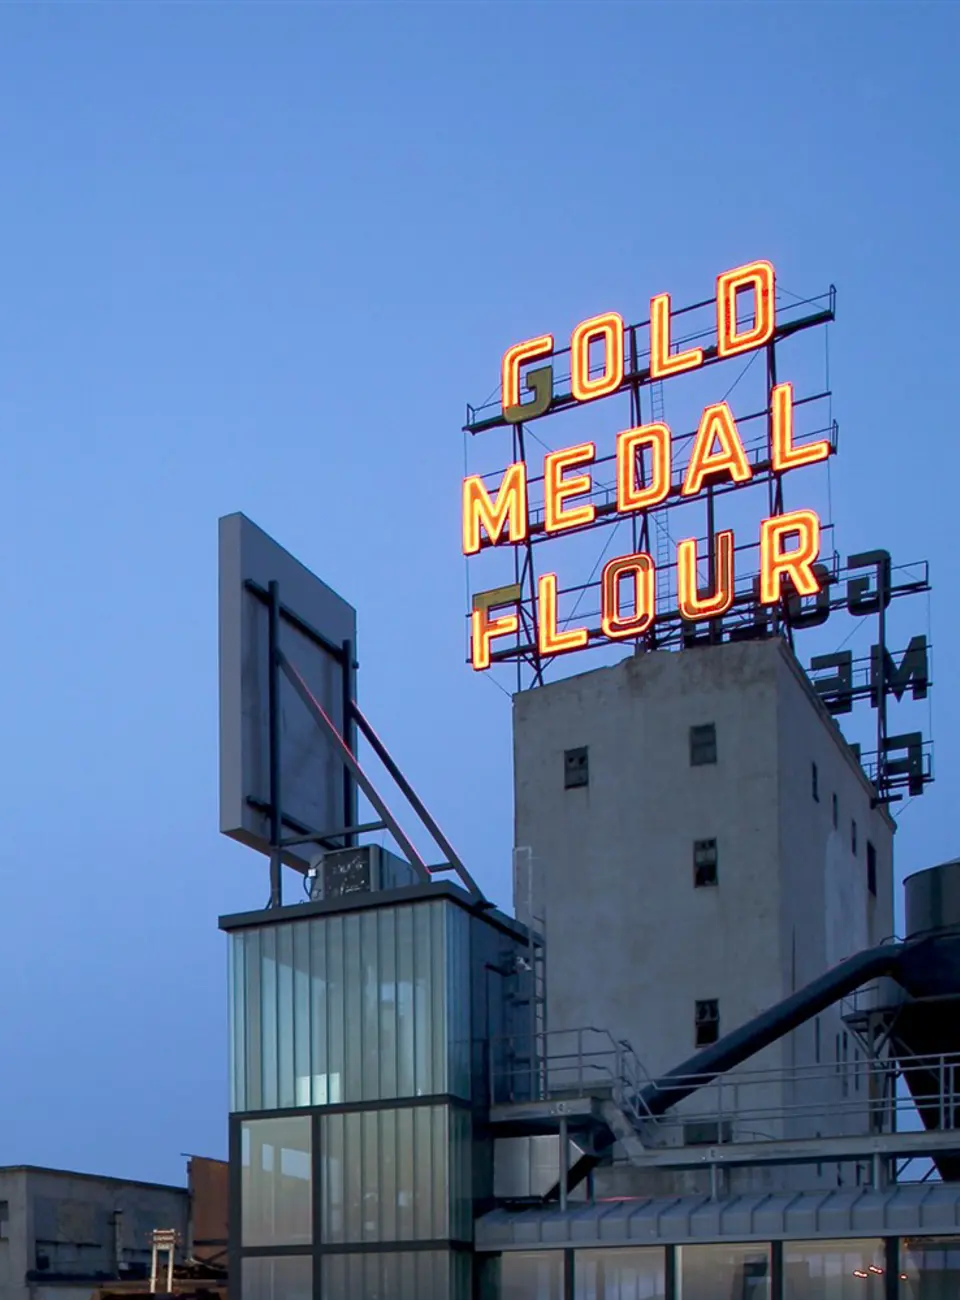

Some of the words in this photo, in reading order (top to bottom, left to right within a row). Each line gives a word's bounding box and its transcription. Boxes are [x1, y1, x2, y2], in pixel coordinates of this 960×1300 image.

[502, 260, 775, 424] GOLD
[462, 382, 831, 556] MEDAL
[471, 509, 821, 671] FLOUR
